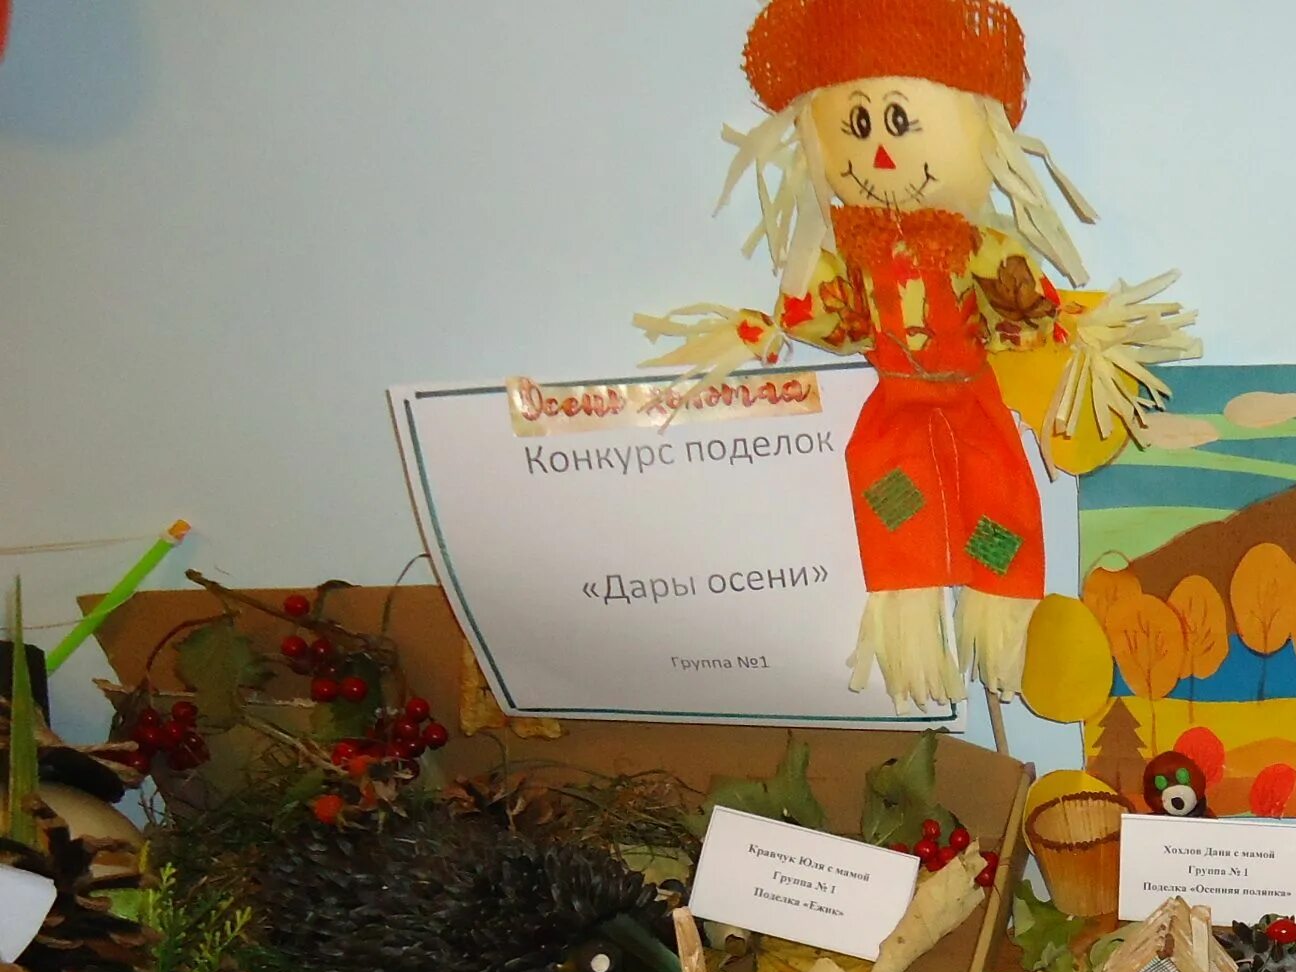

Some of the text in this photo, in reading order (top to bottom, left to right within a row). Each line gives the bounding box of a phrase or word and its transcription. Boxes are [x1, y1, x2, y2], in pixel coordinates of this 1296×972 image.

[525, 430, 834, 475] Конкурс поделок
[582, 563, 829, 605] «Дары осени»
[671, 654, 770, 673] Группа №1
[748, 843, 871, 882] Кравчук Юля с мамой
[1164, 845, 1202, 856] Хохлов
[1204, 847, 1231, 857] Даня
[1242, 850, 1275, 859] мамой
[772, 870, 836, 894] Группа № 1
[1188, 865, 1248, 877] Группа № 1
[1143, 882, 1292, 897] Поделка «Осенняя полянка»
[753, 887, 844, 917] Поделка «Ежик»
